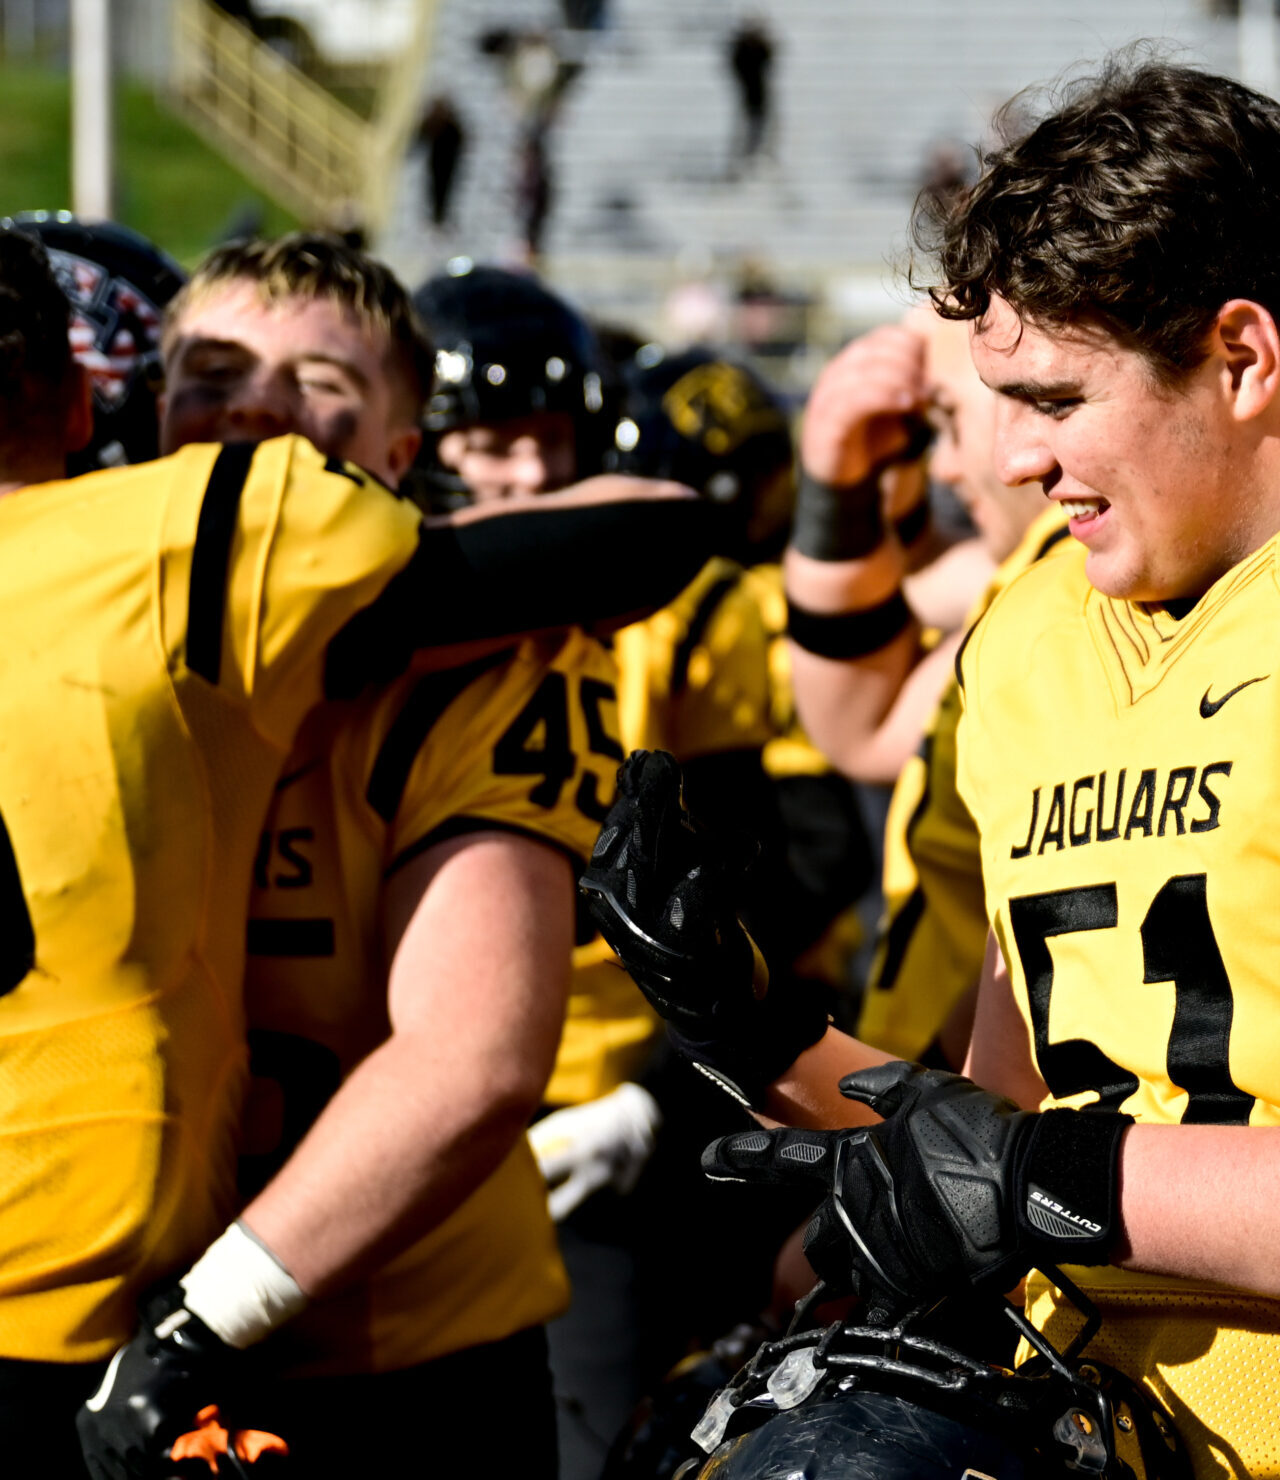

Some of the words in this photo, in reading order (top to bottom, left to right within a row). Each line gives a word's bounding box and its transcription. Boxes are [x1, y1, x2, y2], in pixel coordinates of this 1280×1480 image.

[493, 671, 625, 823] 45
[1010, 760, 1233, 860] JAGUARS
[1009, 872, 1256, 1126] 51
[1030, 1191, 1102, 1232] CUTTERS
